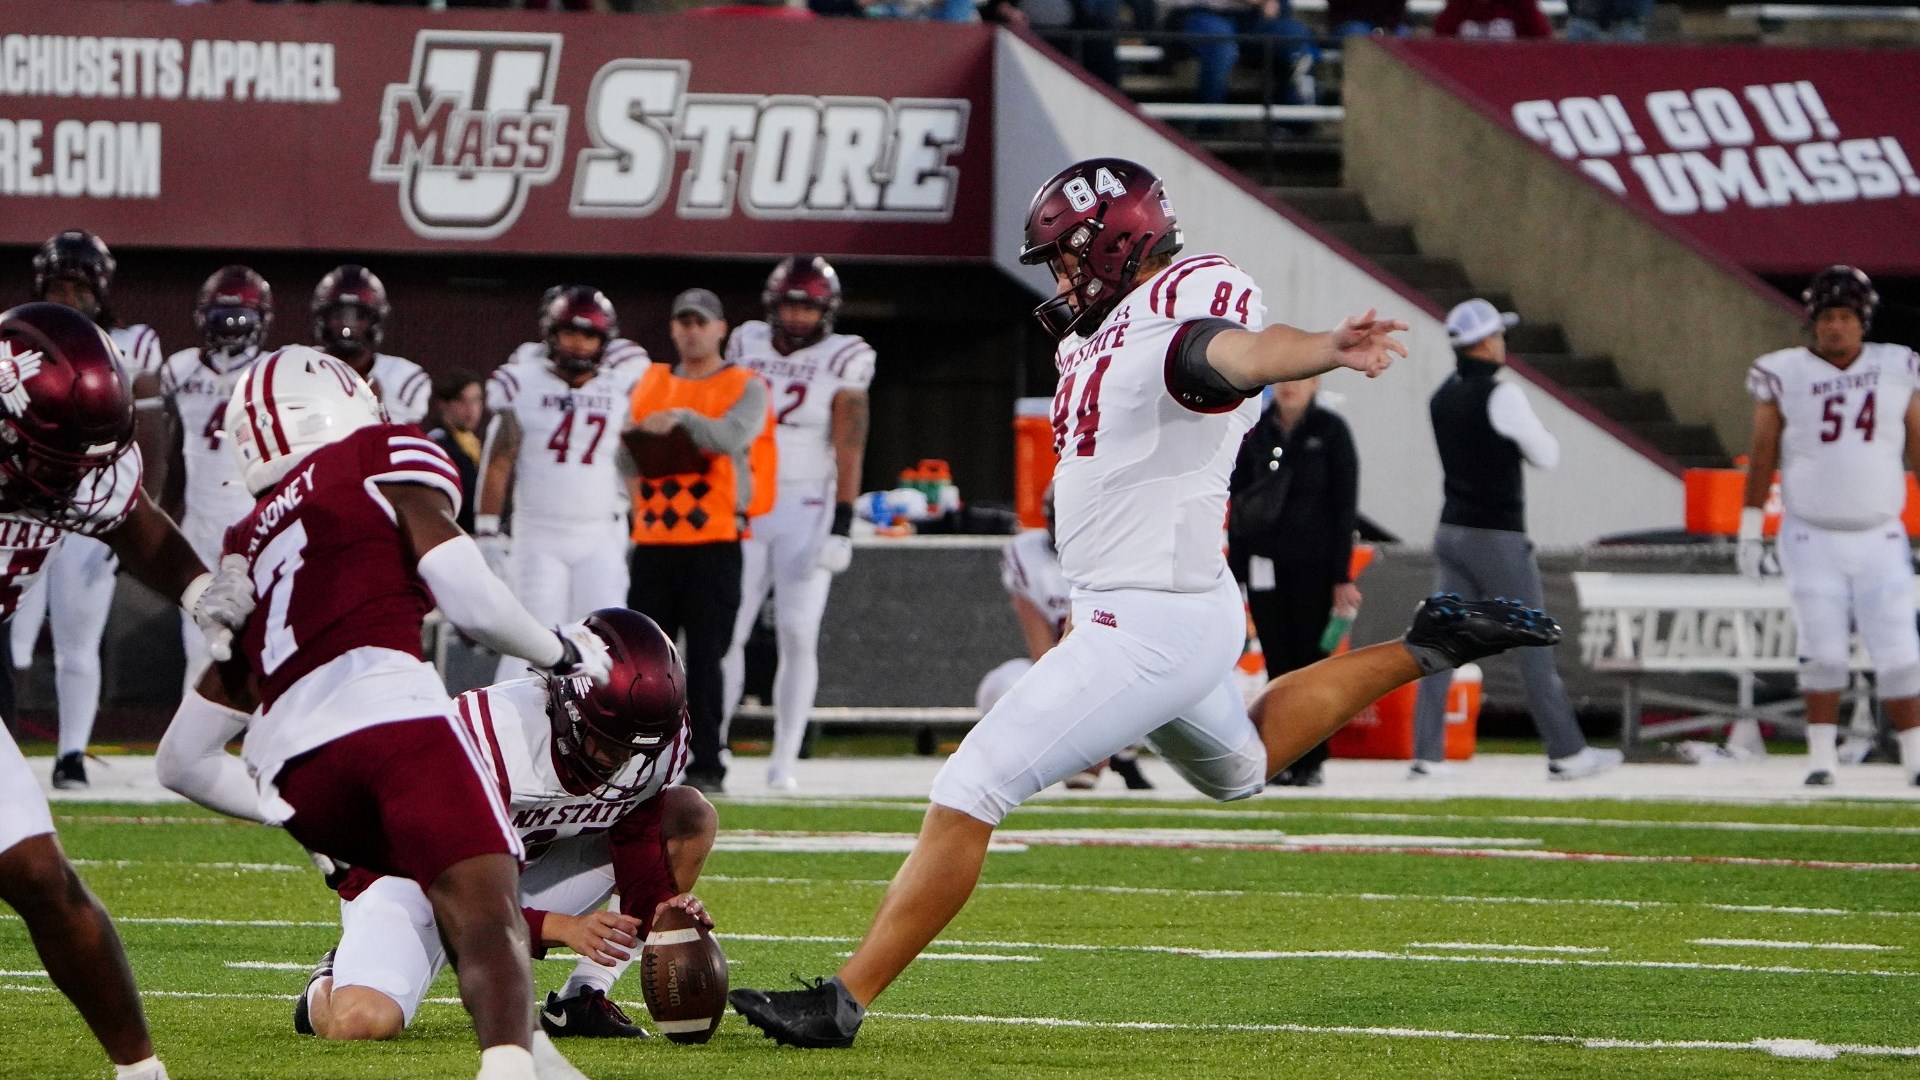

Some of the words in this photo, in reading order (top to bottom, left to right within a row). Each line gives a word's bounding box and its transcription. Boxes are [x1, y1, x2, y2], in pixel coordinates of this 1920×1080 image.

[0, 33, 183, 98] CHUSETTS
[188, 40, 340, 101] APPAREL
[1512, 95, 1646, 159] GO!
[1646, 88, 1754, 149] GO
[1744, 81, 1840, 142] U!
[0, 119, 162, 198] RE.COM
[1631, 136, 1920, 214] UMASS!
[1063, 166, 1127, 212] 84
[1209, 281, 1253, 325] 84
[1074, 322, 1131, 367] STATE
[764, 380, 808, 425] 2
[1820, 391, 1875, 443] 54
[547, 407, 606, 465] 47
[253, 517, 308, 676] 7
[1577, 608, 1799, 661] #FLAGSH
[512, 806, 555, 829] NM
[550, 799, 636, 826] STATE
[667, 960, 682, 1008] Wilson
